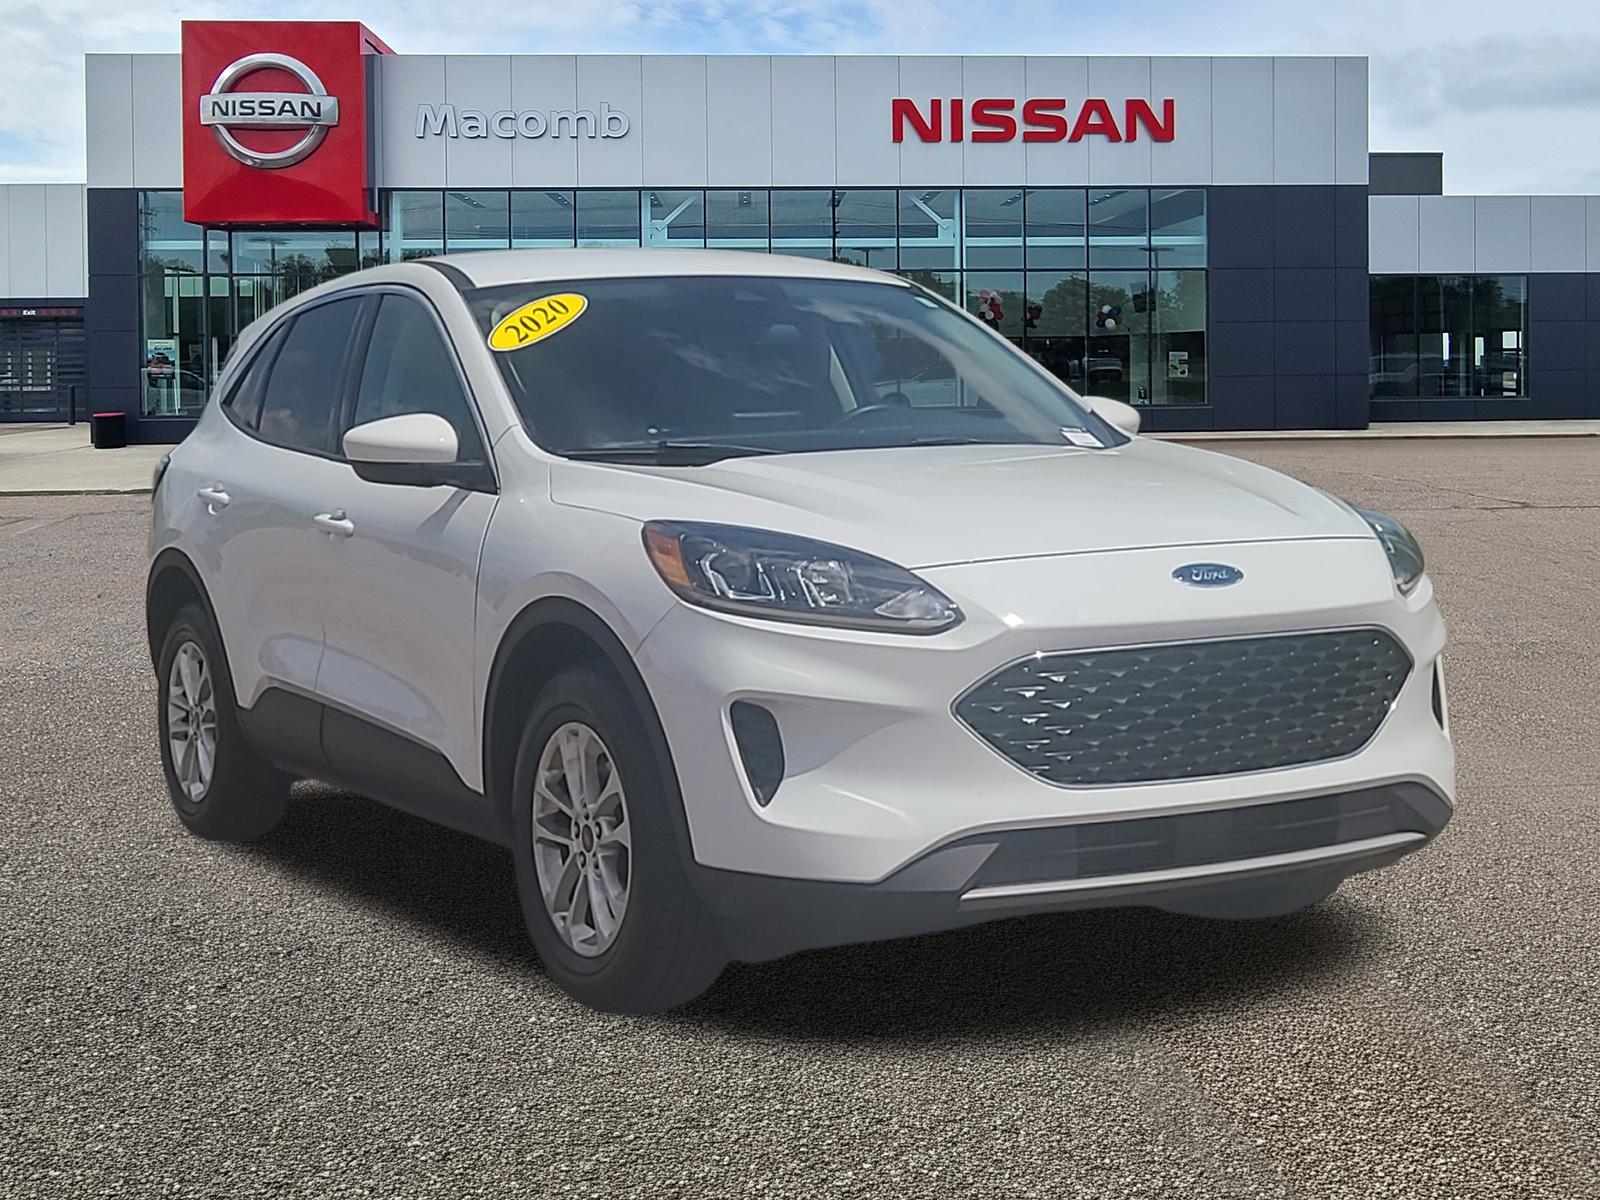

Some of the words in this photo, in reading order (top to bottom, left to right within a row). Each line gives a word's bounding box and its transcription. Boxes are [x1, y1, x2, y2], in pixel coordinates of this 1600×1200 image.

[212, 100, 322, 117] NISSAN
[415, 102, 630, 138] Macomb
[892, 98, 1175, 142] NISSAN
[505, 299, 569, 343] 2020
[1192, 567, 1229, 581] Ford
